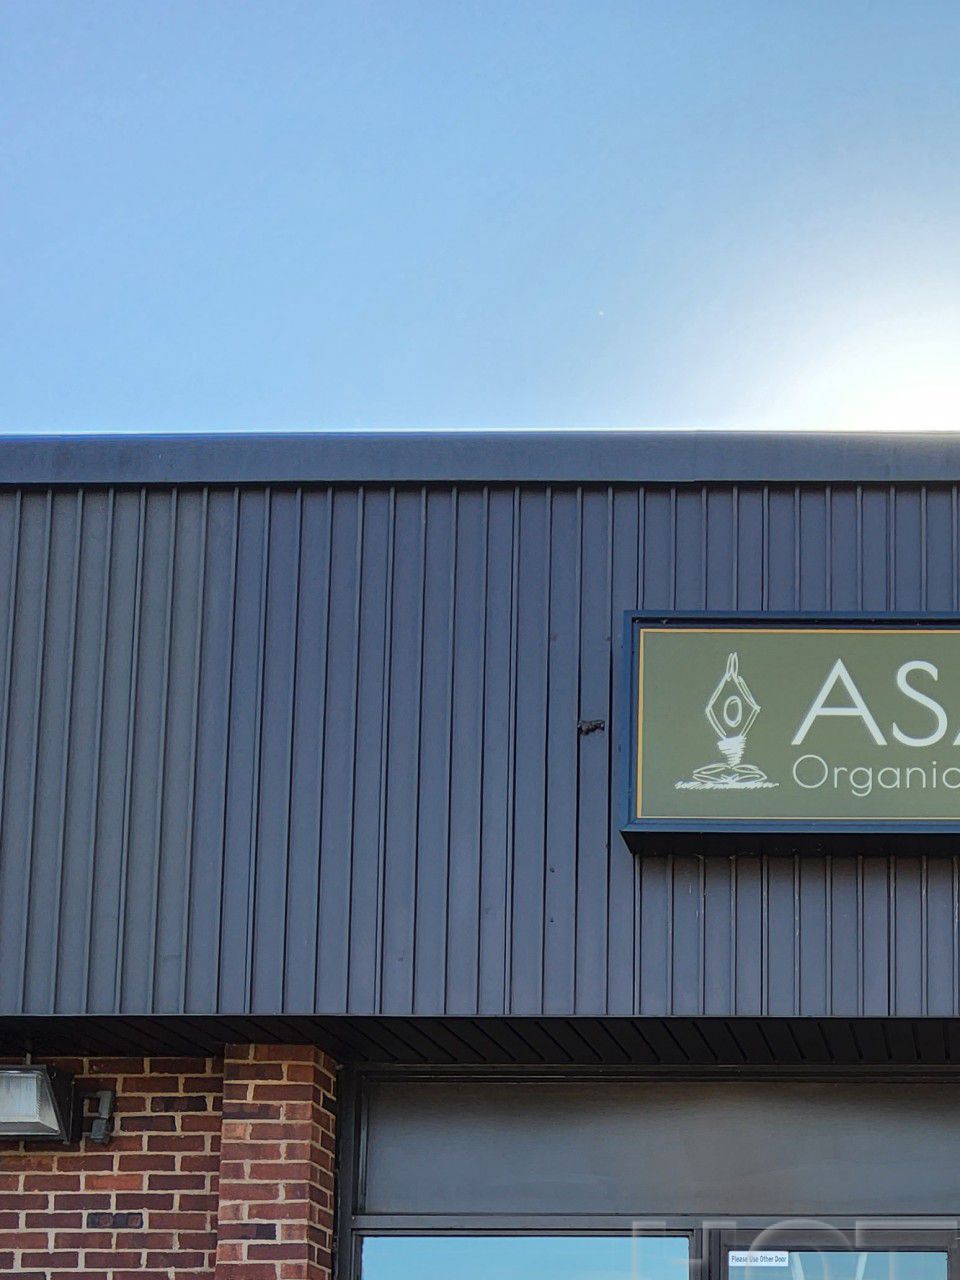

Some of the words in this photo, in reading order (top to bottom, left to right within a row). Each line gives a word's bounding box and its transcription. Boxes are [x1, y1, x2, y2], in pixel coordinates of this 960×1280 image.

[731, 1255, 748, 1263] Please
[759, 1255, 774, 1263] Other
[775, 1255, 787, 1263] Door
